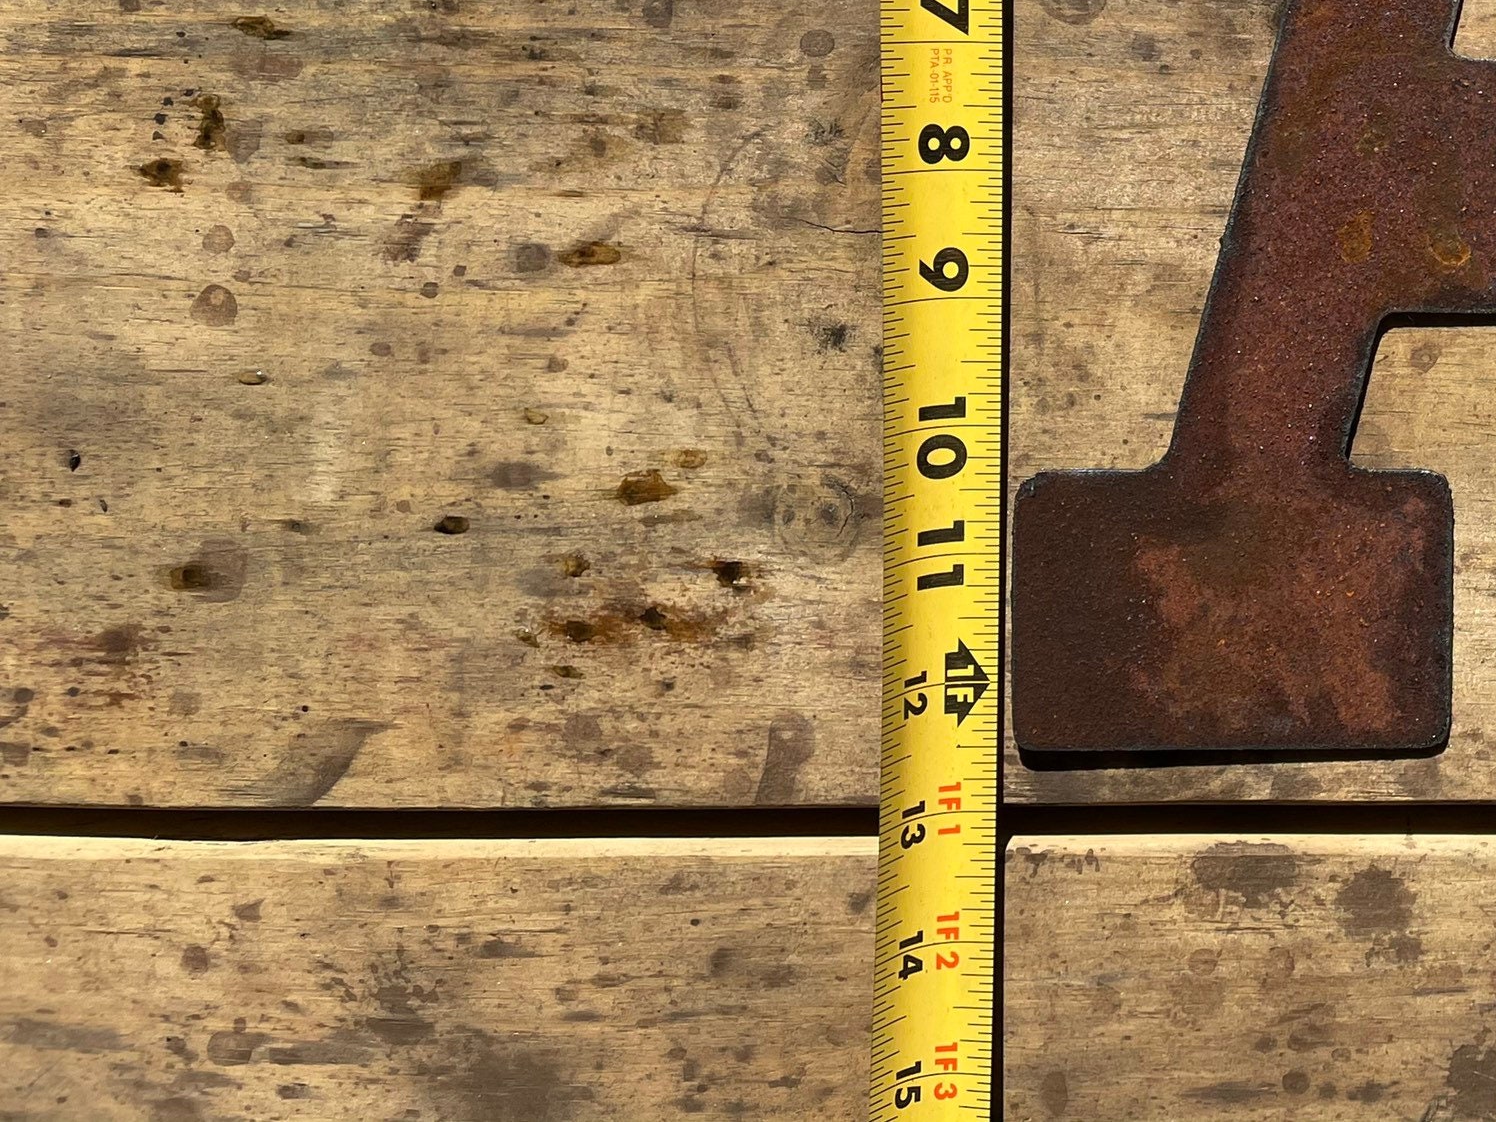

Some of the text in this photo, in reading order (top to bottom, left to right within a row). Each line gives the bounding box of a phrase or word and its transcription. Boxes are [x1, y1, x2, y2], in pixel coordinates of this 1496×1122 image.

[928, 48, 940, 104] PTA-01-115
[918, 123, 970, 165] 8
[919, 247, 969, 292] 9
[916, 396, 969, 480] 10
[916, 519, 966, 592] 11
[903, 671, 928, 721] 12
[944, 664, 976, 704] 1F
[901, 800, 927, 850] 13
[938, 782, 962, 836] 1F 1
[898, 930, 924, 980] 14
[936, 911, 960, 970] 1F 2
[895, 1061, 922, 1110] 15
[934, 1041, 958, 1100] 1F 3
